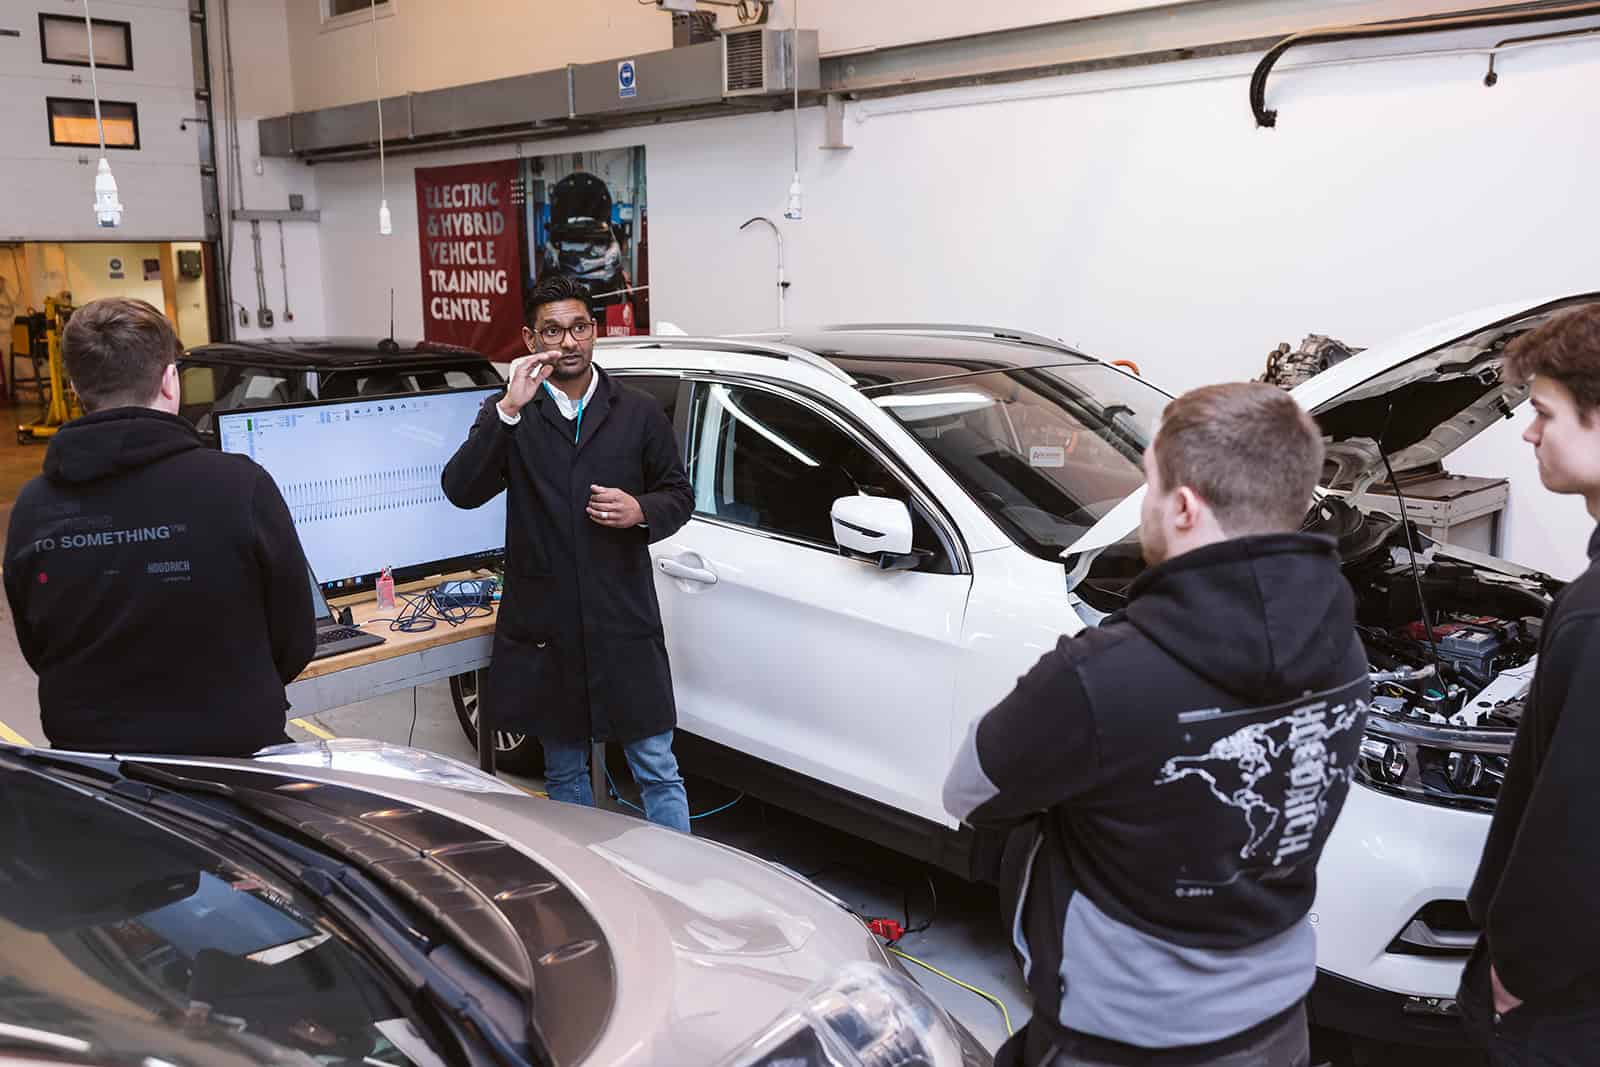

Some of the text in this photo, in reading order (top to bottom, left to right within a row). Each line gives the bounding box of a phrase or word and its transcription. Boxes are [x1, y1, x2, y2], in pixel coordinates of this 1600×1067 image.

[424, 182, 499, 209] ELECTRIC
[427, 211, 504, 237] & HYBRID
[427, 240, 497, 265] VEHICLE
[429, 269, 508, 295] TRAINING
[431, 297, 492, 323] CENTRE
[34, 537, 55, 552] TO
